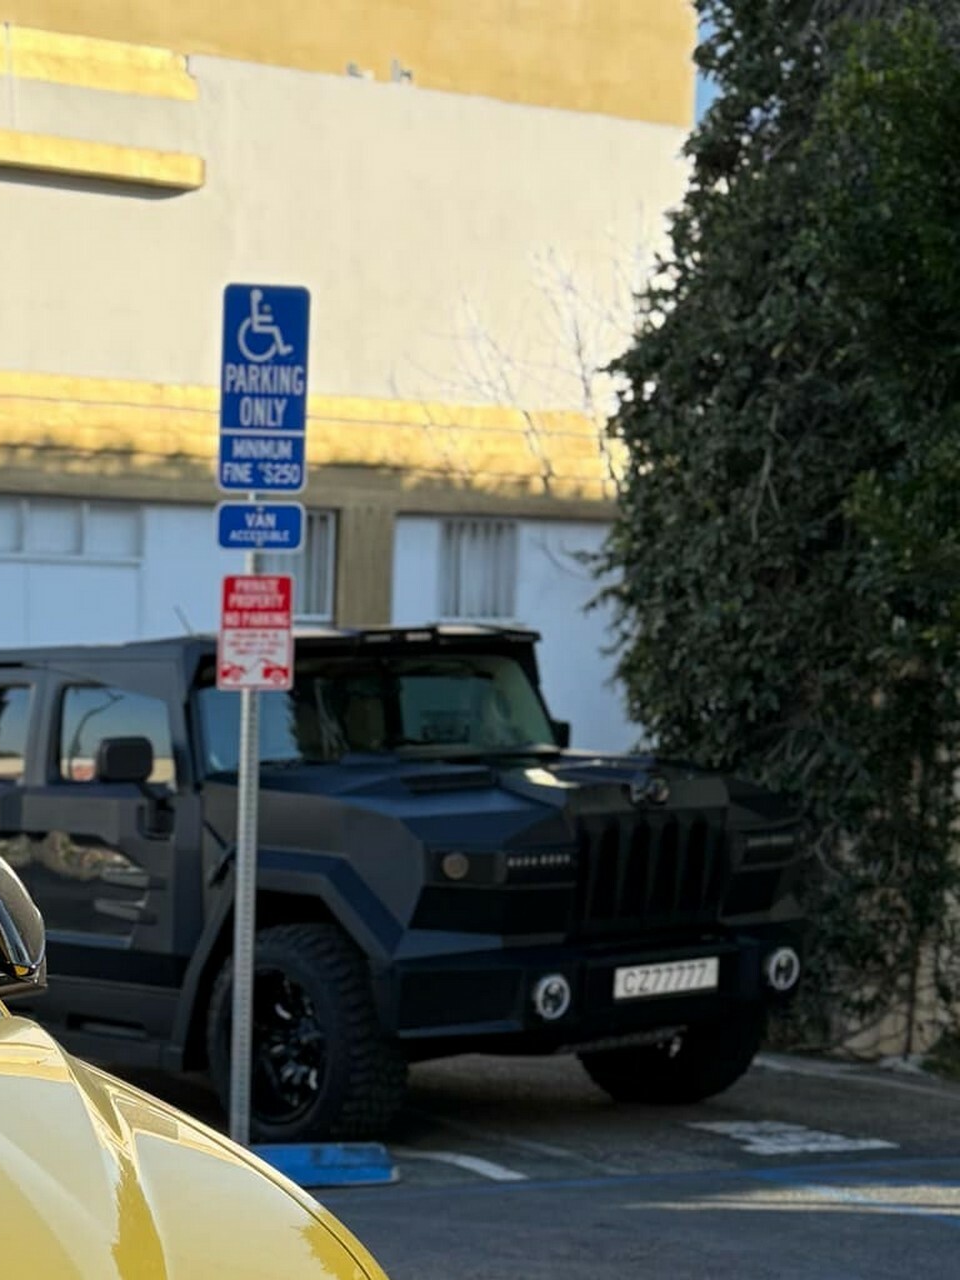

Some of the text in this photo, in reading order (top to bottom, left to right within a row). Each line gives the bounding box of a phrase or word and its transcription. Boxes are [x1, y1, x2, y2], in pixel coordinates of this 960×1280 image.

[225, 363, 305, 396] PARKING
[240, 396, 288, 428] ONLY
[232, 439, 293, 460] MINIMUM
[223, 463, 253, 483] FINE
[244, 513, 277, 529] VAN
[228, 593, 285, 609] PROPERTY
[224, 611, 290, 627] NO PARKING
